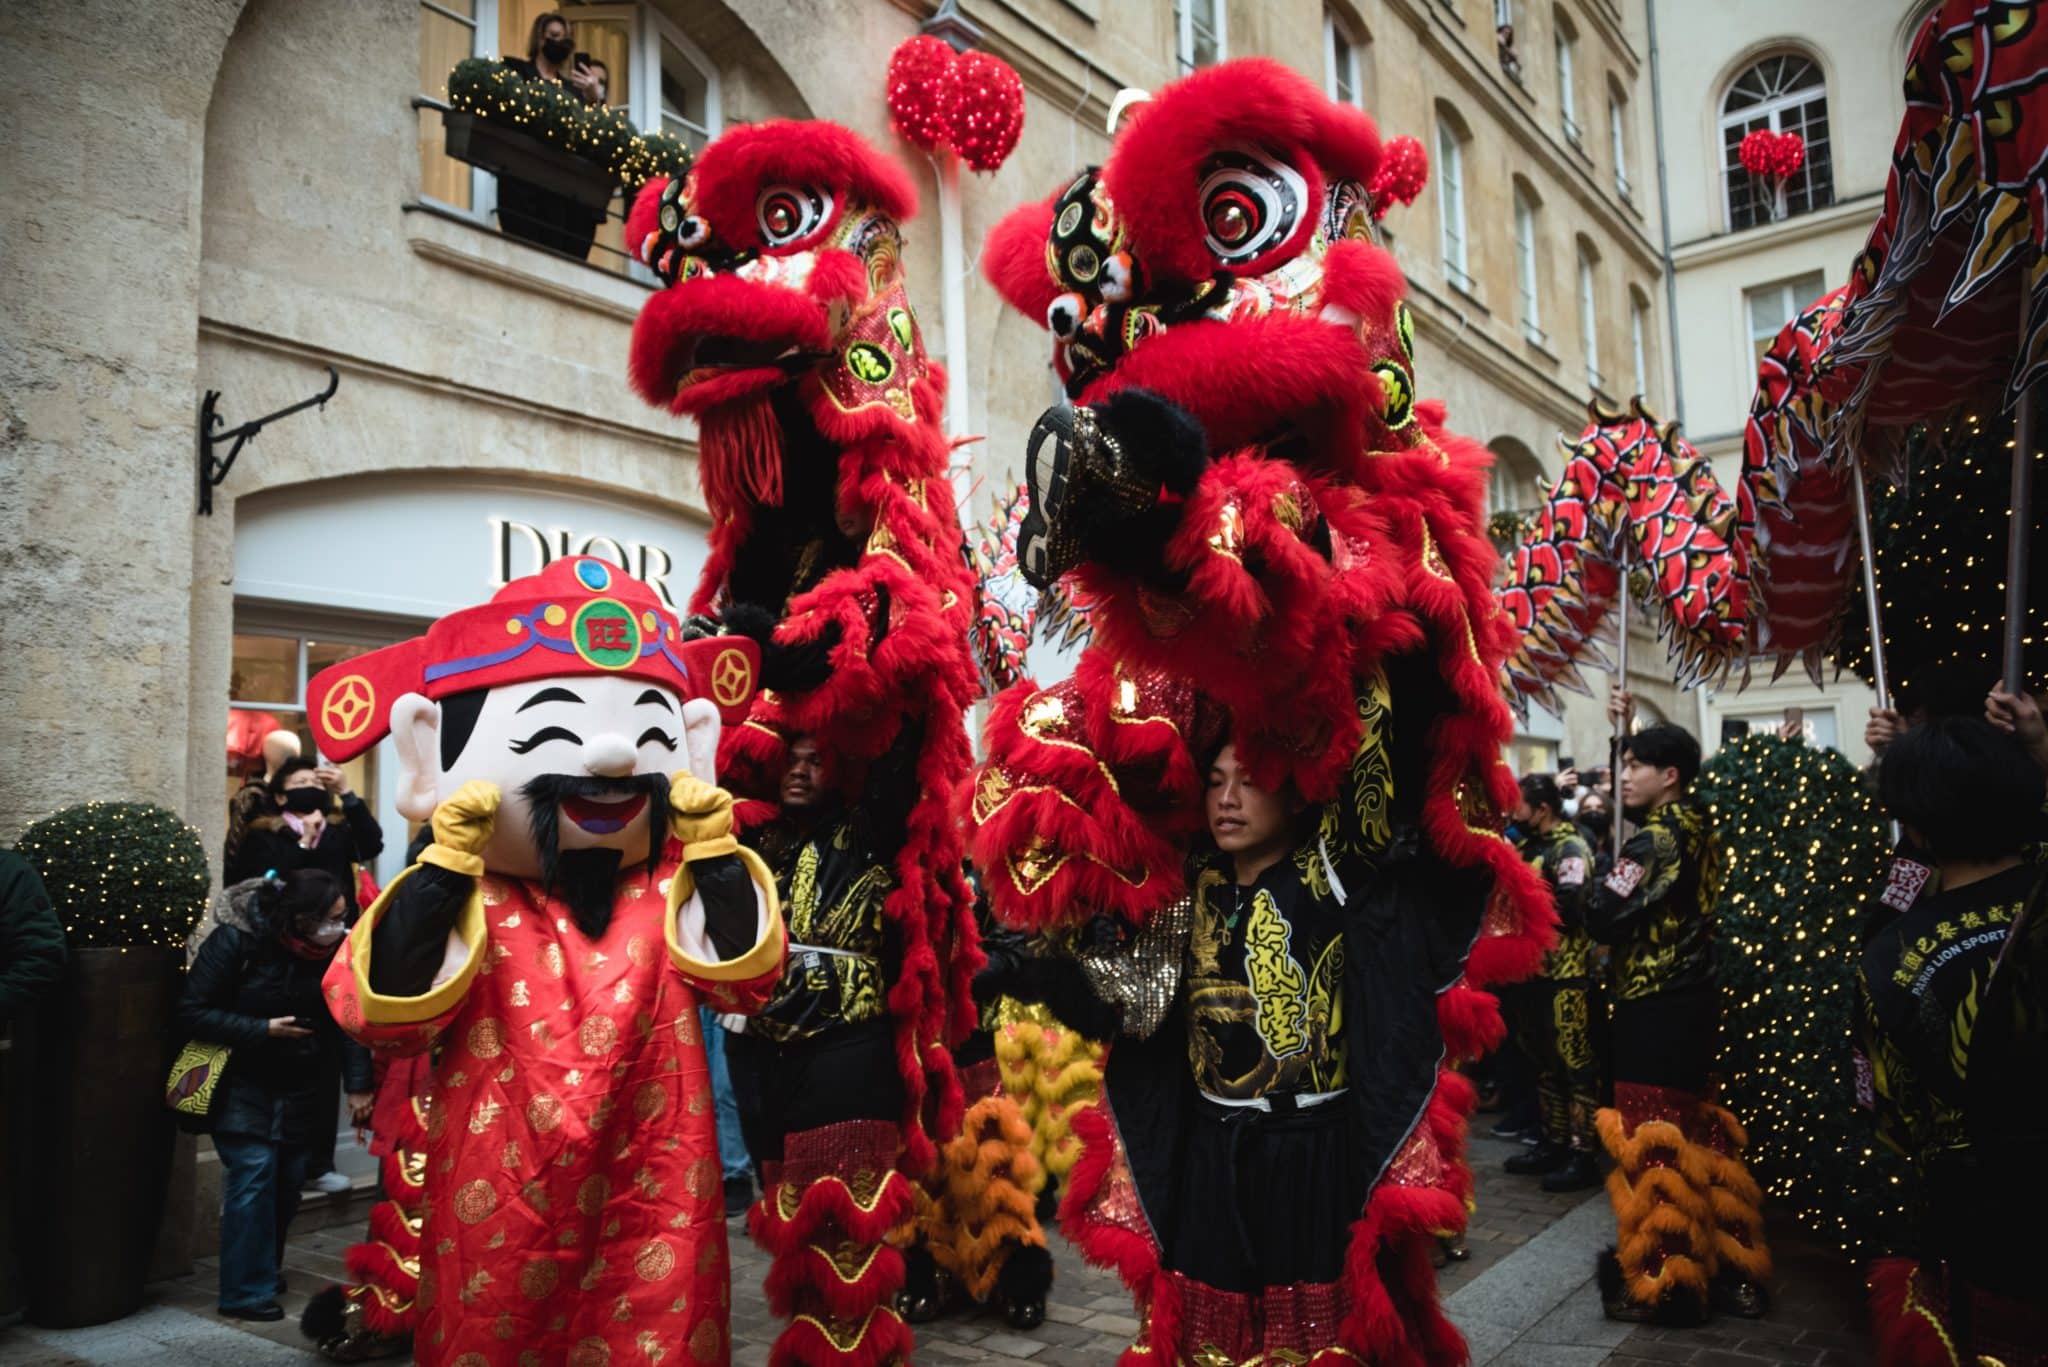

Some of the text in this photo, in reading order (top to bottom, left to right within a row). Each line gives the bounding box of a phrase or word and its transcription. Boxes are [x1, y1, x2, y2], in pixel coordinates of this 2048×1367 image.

[585, 617, 632, 652] 旺
[1911, 929, 2007, 997] PARIS LION SPORT
